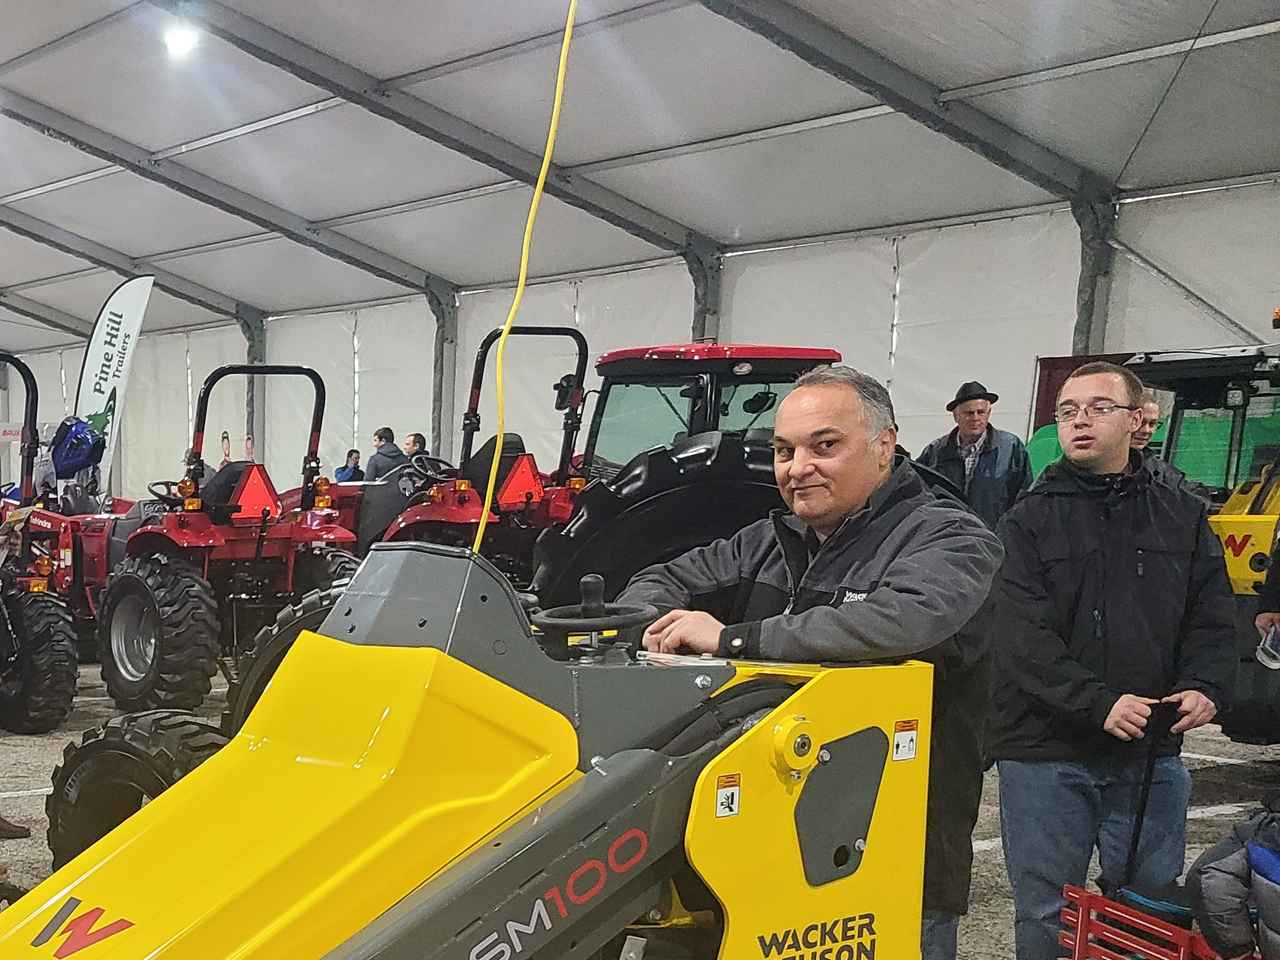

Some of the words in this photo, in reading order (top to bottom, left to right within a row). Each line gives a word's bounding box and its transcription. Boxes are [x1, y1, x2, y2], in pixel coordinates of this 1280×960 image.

[93, 351, 114, 395] Pine
[104, 310, 124, 347] Hill
[111, 332, 131, 379] Trailers
[757, 913, 876, 959] WACKER
